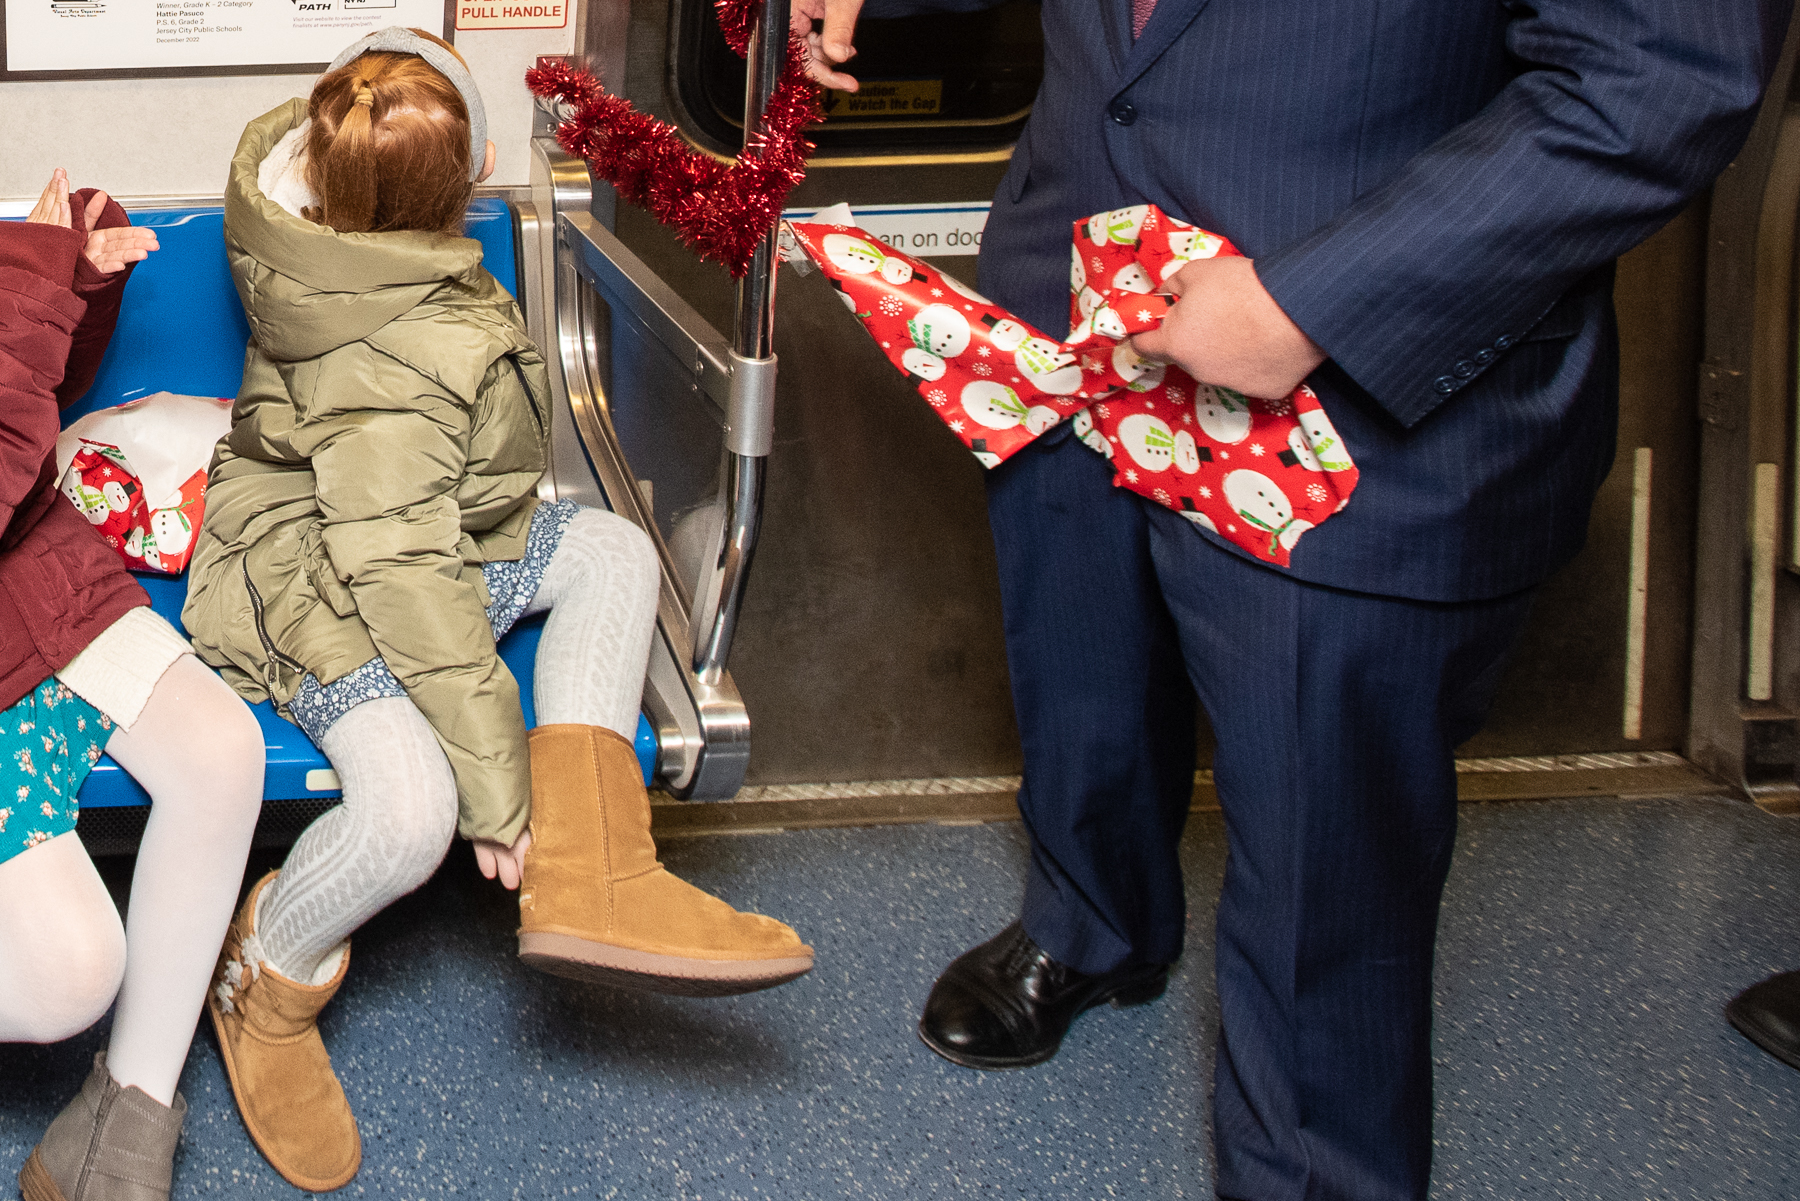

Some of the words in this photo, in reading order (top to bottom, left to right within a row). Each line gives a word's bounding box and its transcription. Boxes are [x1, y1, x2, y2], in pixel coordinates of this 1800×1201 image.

[223, 0, 253, 8] Category
[298, 3, 332, 11] PATH
[461, 6, 499, 18] PULL
[502, 5, 562, 18] HANDLE
[850, 86, 899, 97] aution:
[849, 98, 886, 111] Watch
[891, 98, 909, 110] the
[912, 97, 936, 111] Gap
[912, 232, 938, 247] on
[946, 228, 983, 247] doo
